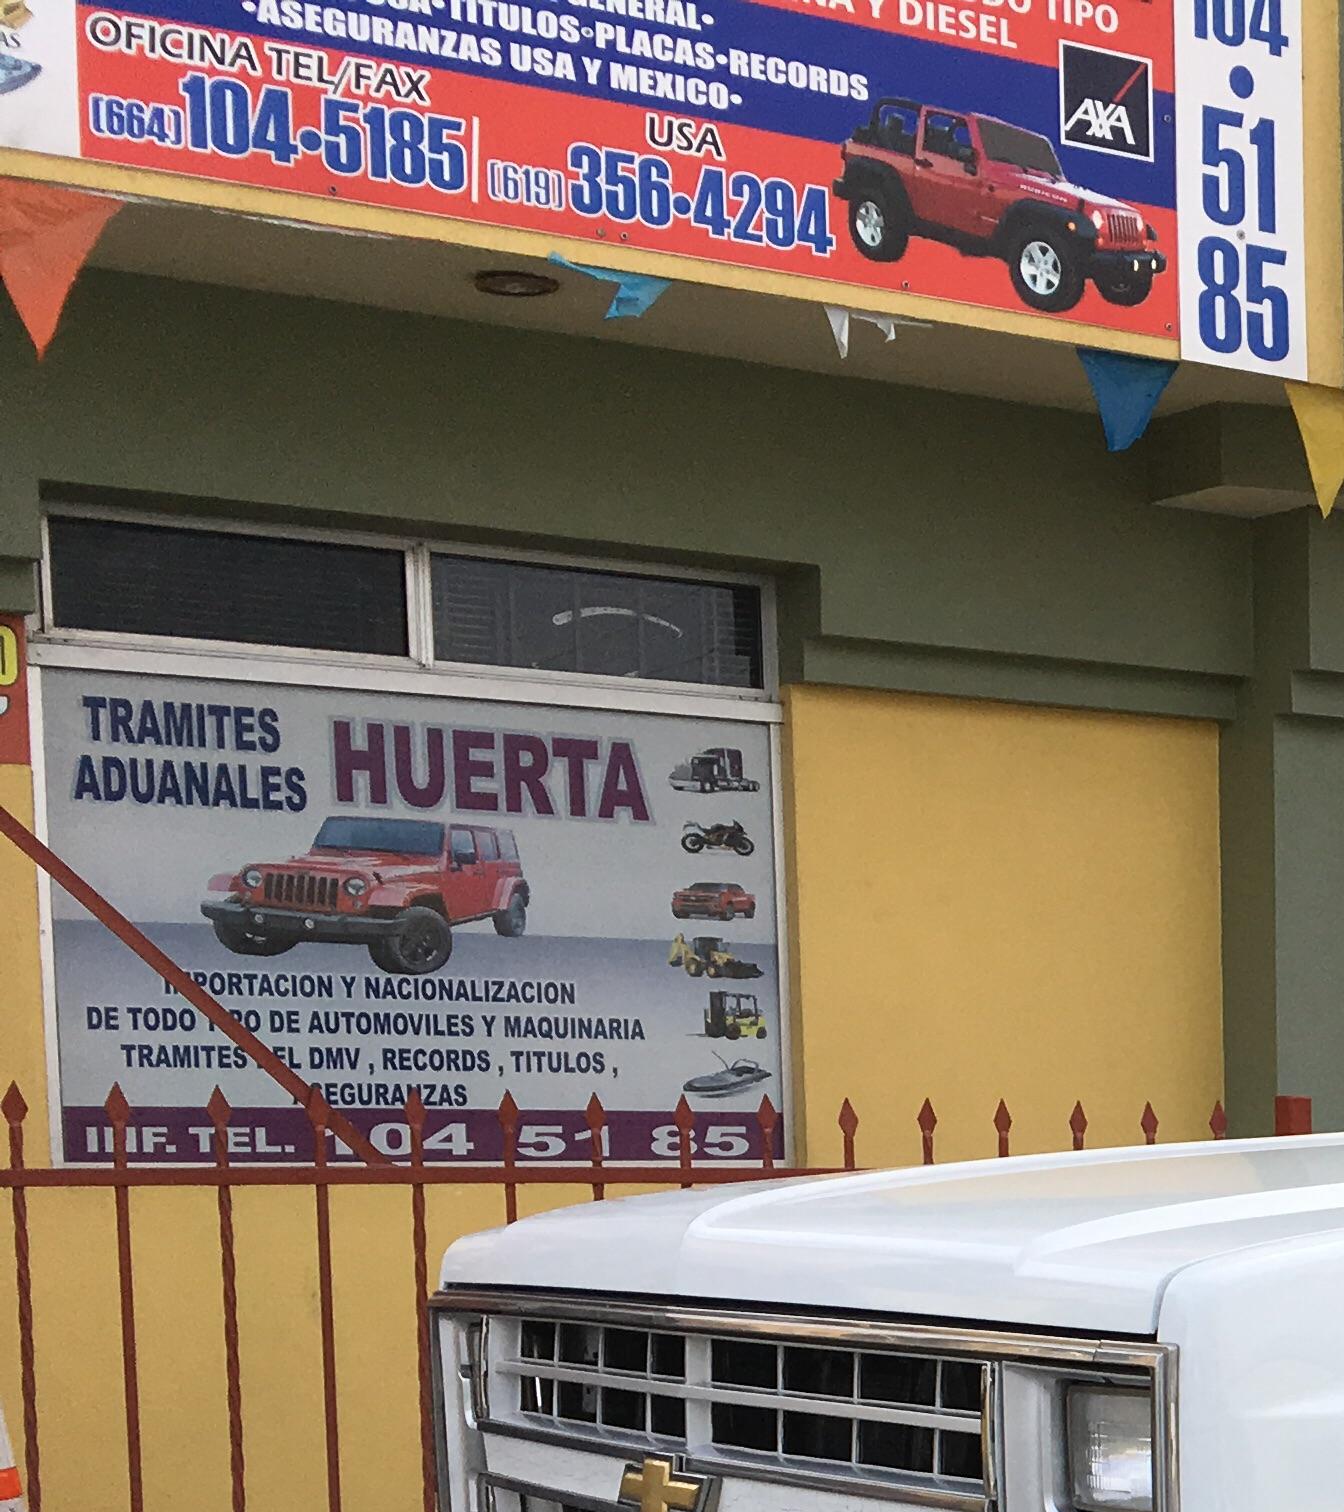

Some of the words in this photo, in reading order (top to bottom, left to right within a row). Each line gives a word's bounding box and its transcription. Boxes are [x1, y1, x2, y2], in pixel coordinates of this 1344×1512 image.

[256, 0, 501, 67] ASEGURANZAS
[510, 44, 577, 80] USA
[582, 57, 602, 86] Y
[899, 0, 1018, 48] DIESEL
[89, 16, 259, 73] OFICINA
[270, 47, 427, 102] TEL/FAX
[729, 48, 869, 101] RECORDS
[648, 115, 723, 157] USA
[1065, 98, 1136, 145] AXA
[1200, 104, 1277, 234] 51
[1198, 236, 1290, 363] 85
[82, 694, 281, 753] TRAMITES
[74, 754, 308, 813] ADUANALES
[332, 719, 651, 822] HUERTA
[340, 976, 357, 999] Y
[364, 976, 576, 1005] NACIONALIZACION
[86, 1006, 120, 1031] DE
[126, 1007, 197, 1032] TODO
[208, 1009, 261, 1033] PO
[269, 1010, 301, 1034] DE
[308, 1010, 475, 1038] AUTOMOVILES
[481, 1015, 497, 1038] Y
[503, 1015, 646, 1041] MAQUINARIA
[120, 1044, 248, 1069] TRAMITES
[257, 1046, 301, 1069] EL
[308, 1047, 361, 1070] DMV
[381, 1048, 491, 1073] RECORDS
[510, 1050, 606, 1074] TITULOS
[293, 1083, 467, 1107] EGURAZAS
[650, 1125, 750, 1157] 85
